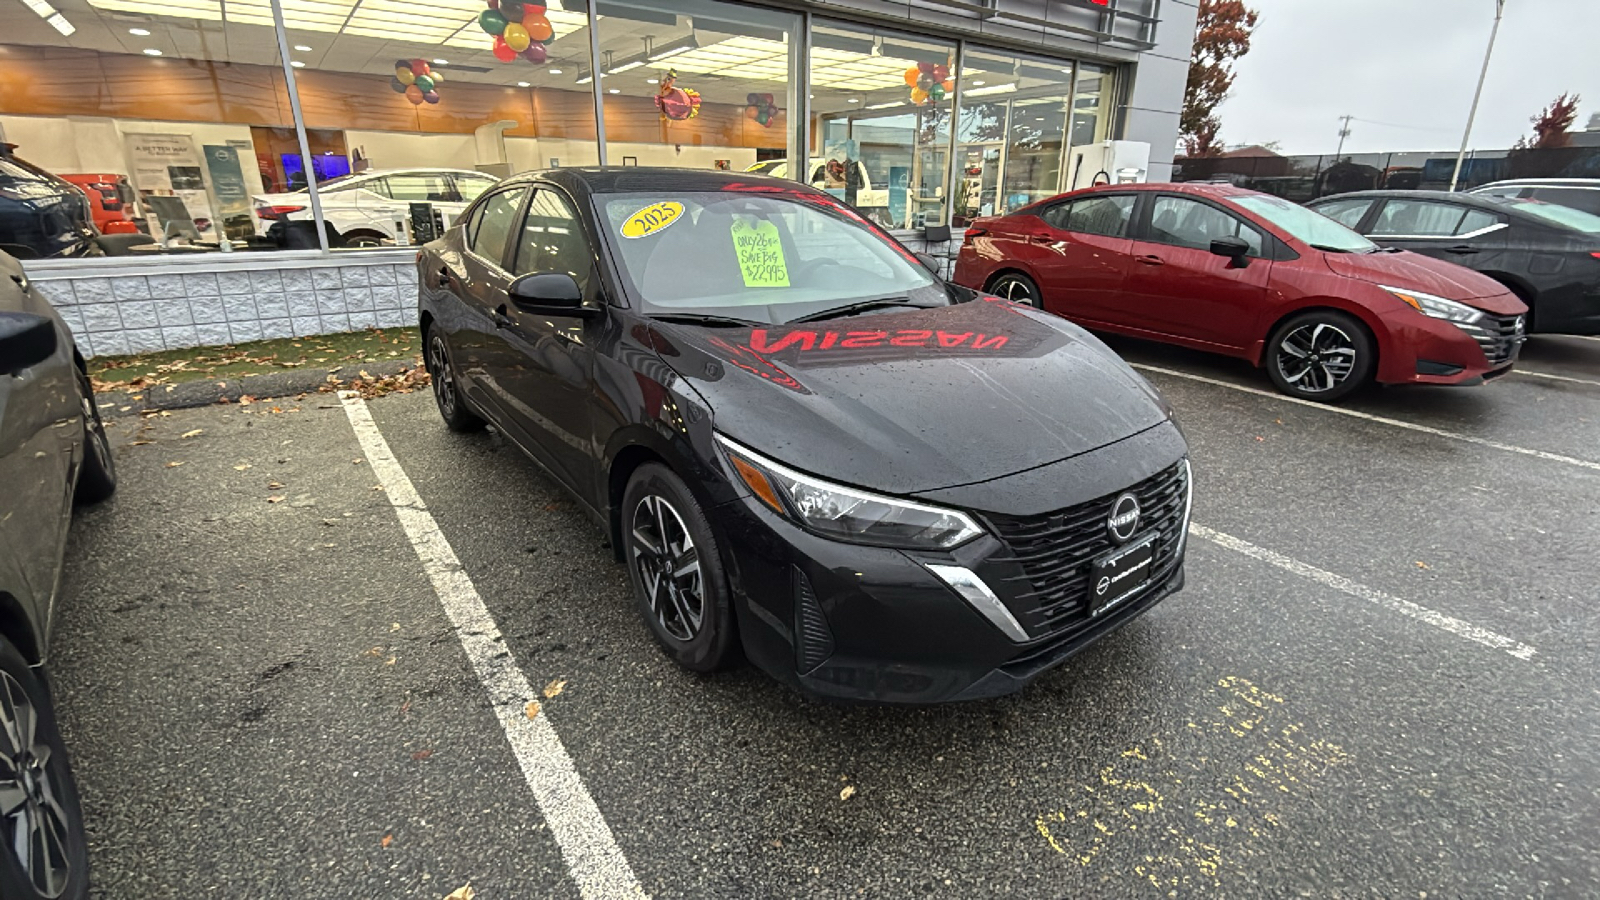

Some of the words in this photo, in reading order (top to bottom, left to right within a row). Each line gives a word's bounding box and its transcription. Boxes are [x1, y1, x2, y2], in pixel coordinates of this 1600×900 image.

[635, 203, 676, 232] 2025
[737, 235, 757, 251] ONLY
[756, 233, 768, 247] 26
[741, 250, 761, 264] SAVE
